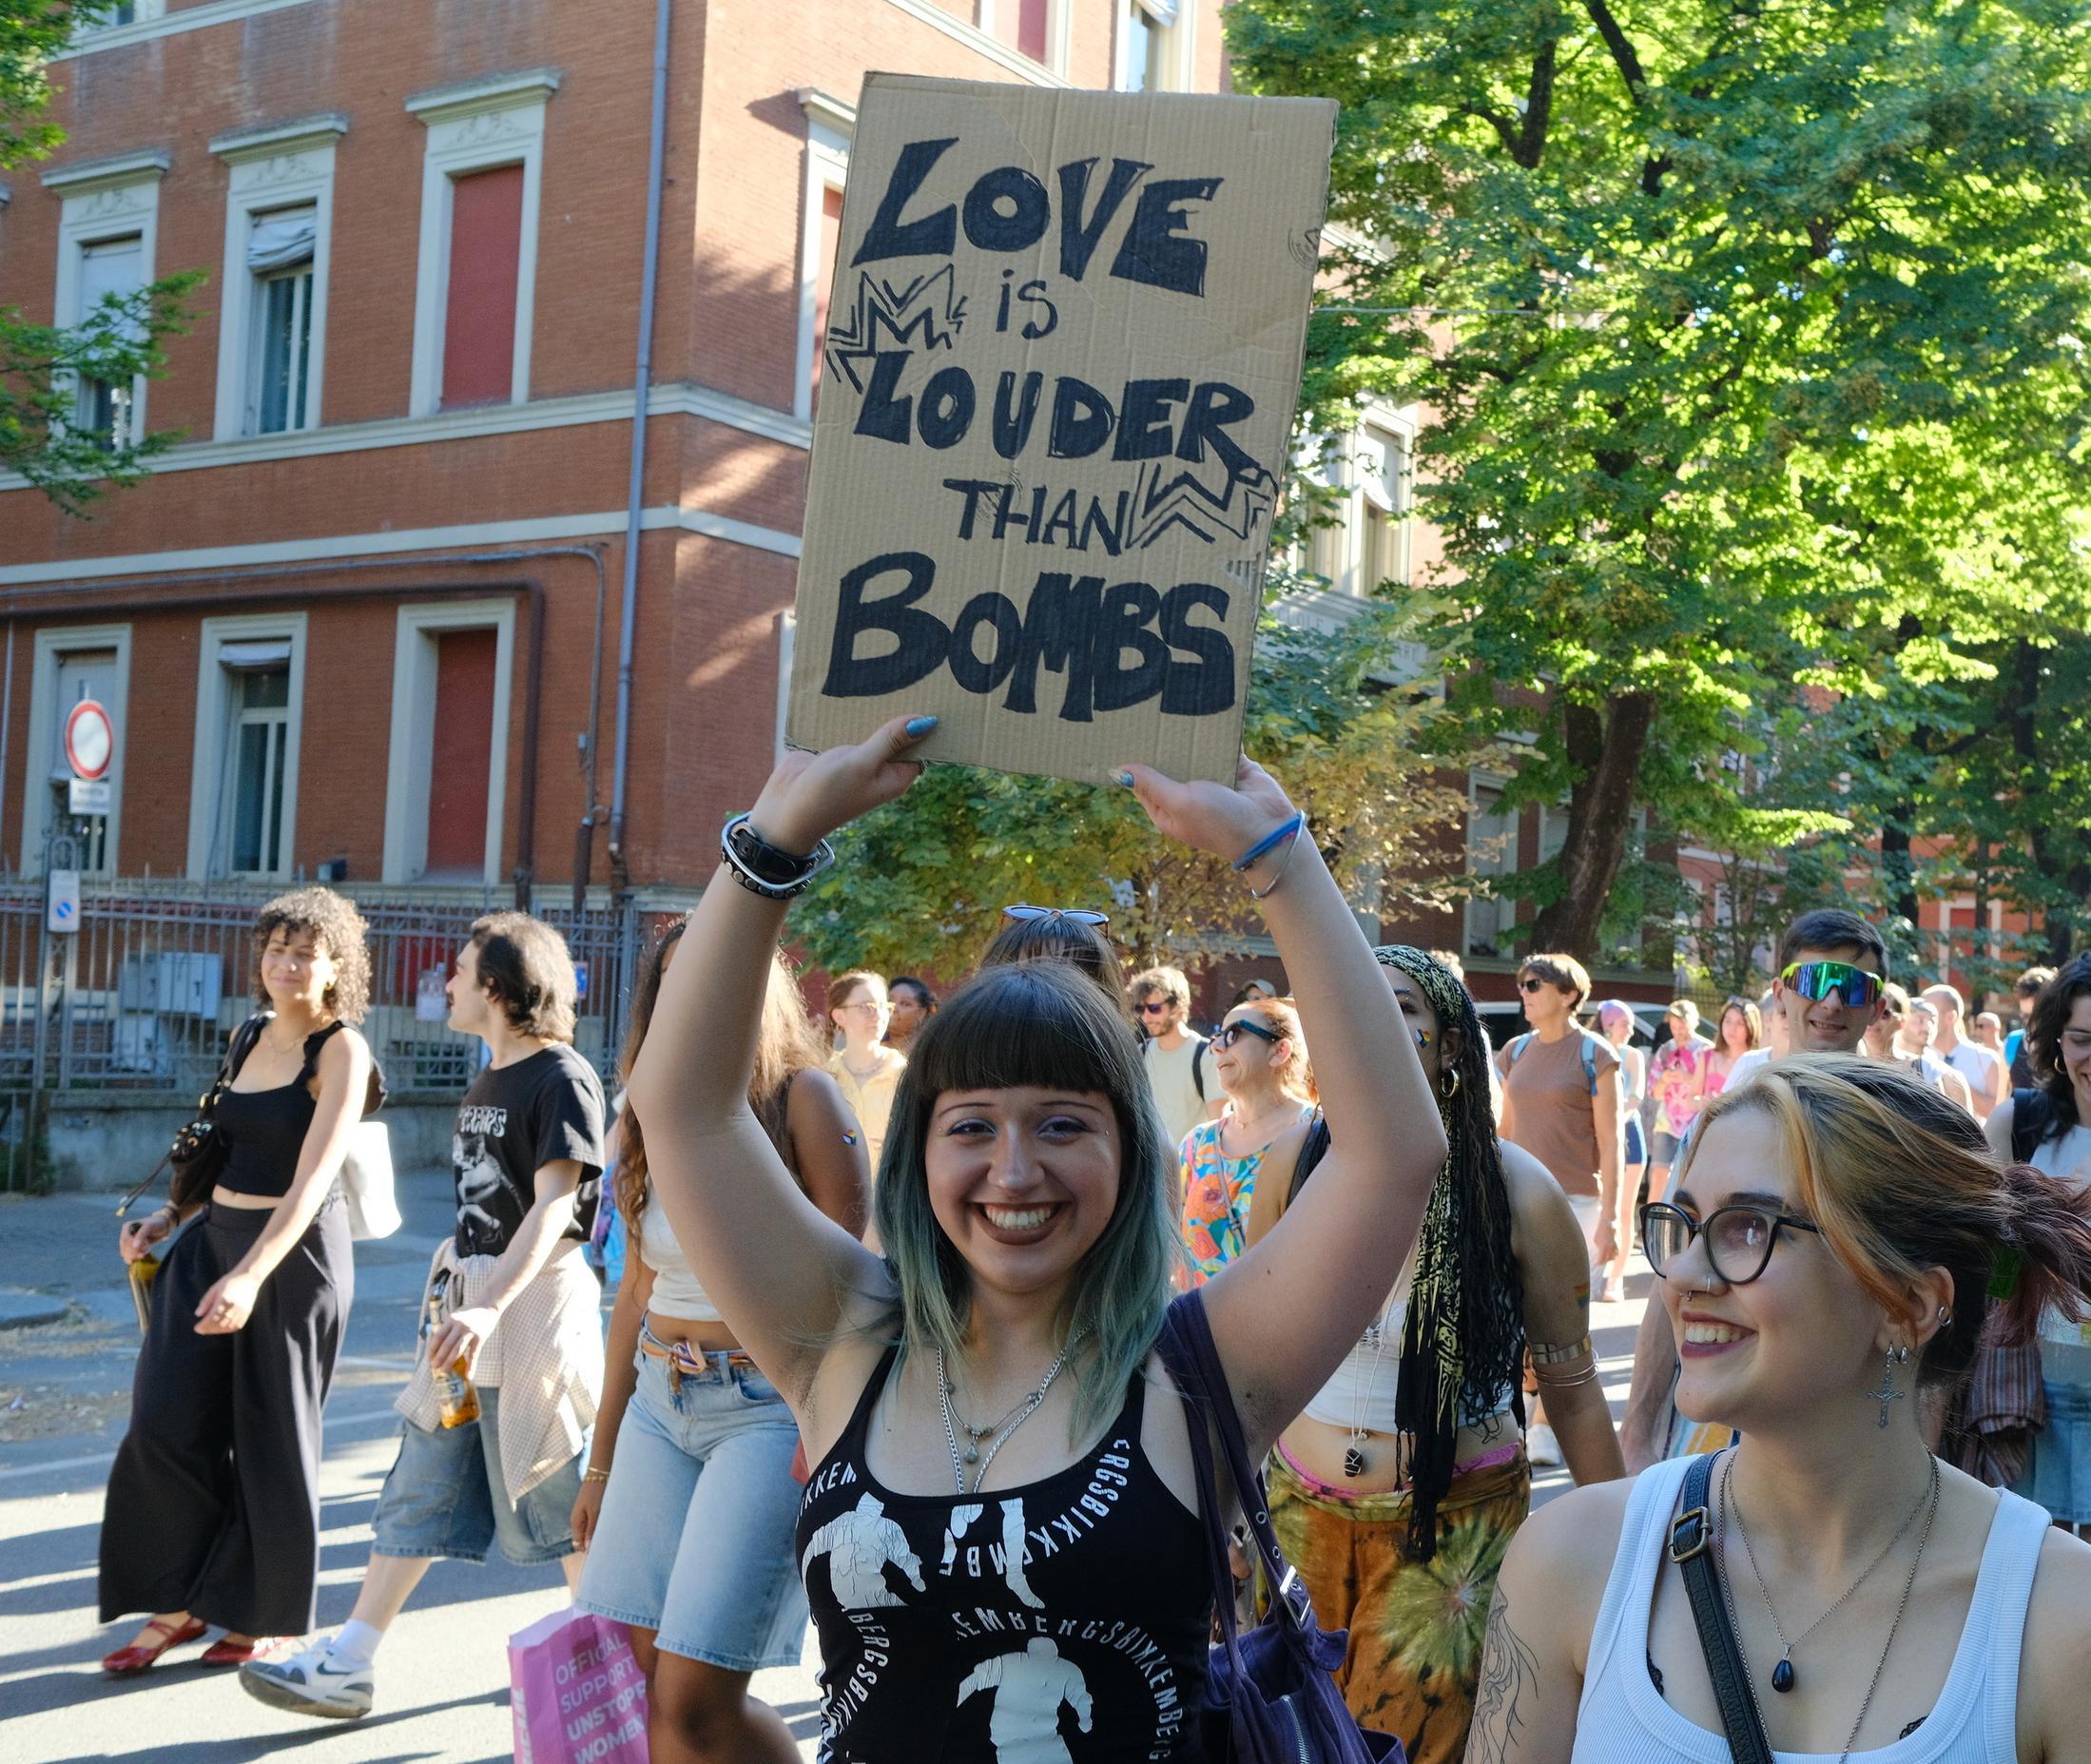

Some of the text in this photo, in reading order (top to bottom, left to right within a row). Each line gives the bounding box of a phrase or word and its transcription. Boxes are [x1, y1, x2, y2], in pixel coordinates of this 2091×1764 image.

[851, 137, 1225, 297] LOVE
[854, 350, 1263, 480] LOUDER
[942, 478, 1138, 556] THAN
[822, 552, 1235, 723] BOMBS
[554, 1633, 628, 1685] OFFICIAL
[560, 1655, 635, 1715] SUPPORT
